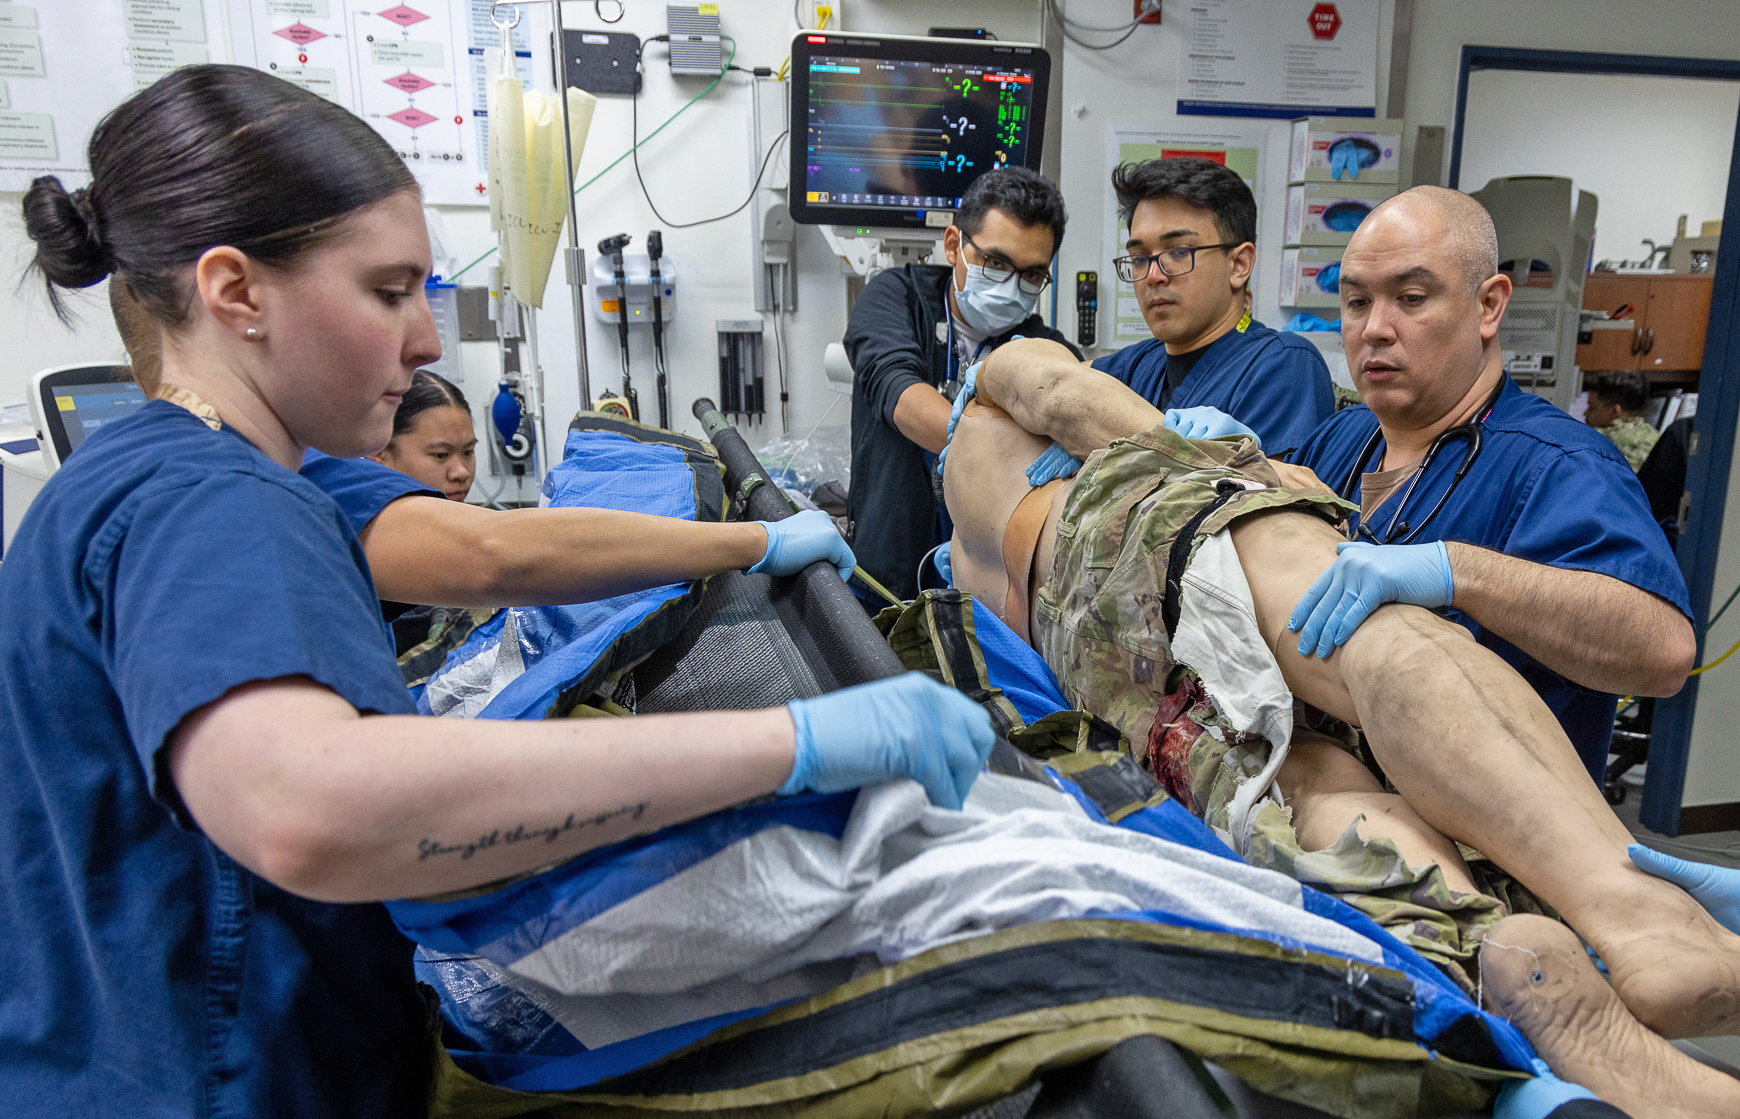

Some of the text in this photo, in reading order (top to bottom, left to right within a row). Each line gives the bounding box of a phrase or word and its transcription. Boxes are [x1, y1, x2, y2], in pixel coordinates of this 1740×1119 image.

[1314, 13, 1335, 22] TIME
[1316, 22, 1332, 31] OUT
[417, 828, 499, 862] Strength
